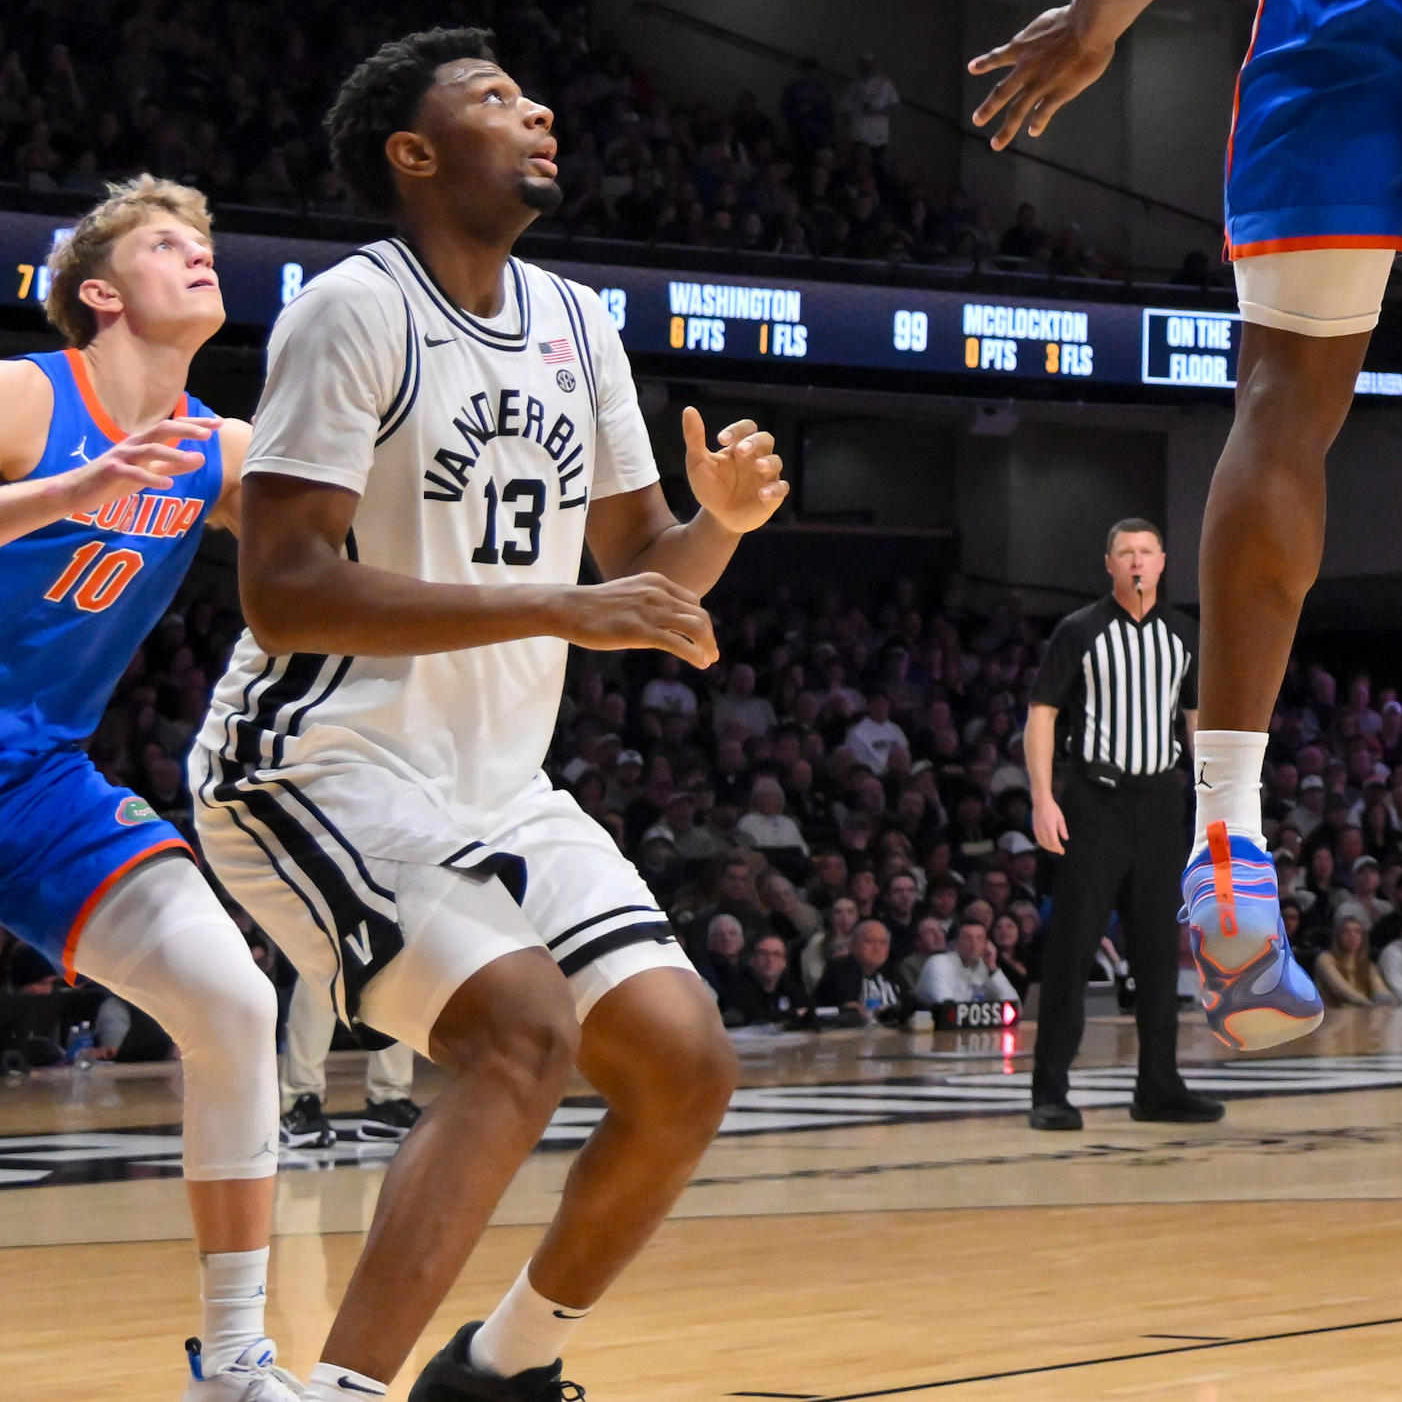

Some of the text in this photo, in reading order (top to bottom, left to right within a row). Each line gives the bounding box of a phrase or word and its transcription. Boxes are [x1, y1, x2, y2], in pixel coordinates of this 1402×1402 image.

[17, 263, 32, 299] 7
[669, 281, 801, 324] WASHINGTON
[962, 303, 1089, 344] MCGLOCKTON
[670, 316, 807, 358] 6 PTS 1 FLS
[893, 310, 928, 352] 99
[1166, 317, 1232, 350] ON THE
[965, 337, 1094, 377] 0 PTS 3 FLS
[1169, 353, 1228, 384] FLOOR
[424, 389, 588, 512] VANDERBILT
[471, 476, 547, 567] 13
[44, 540, 145, 614] 10
[344, 919, 374, 968] V
[956, 1002, 1002, 1026] POSS
